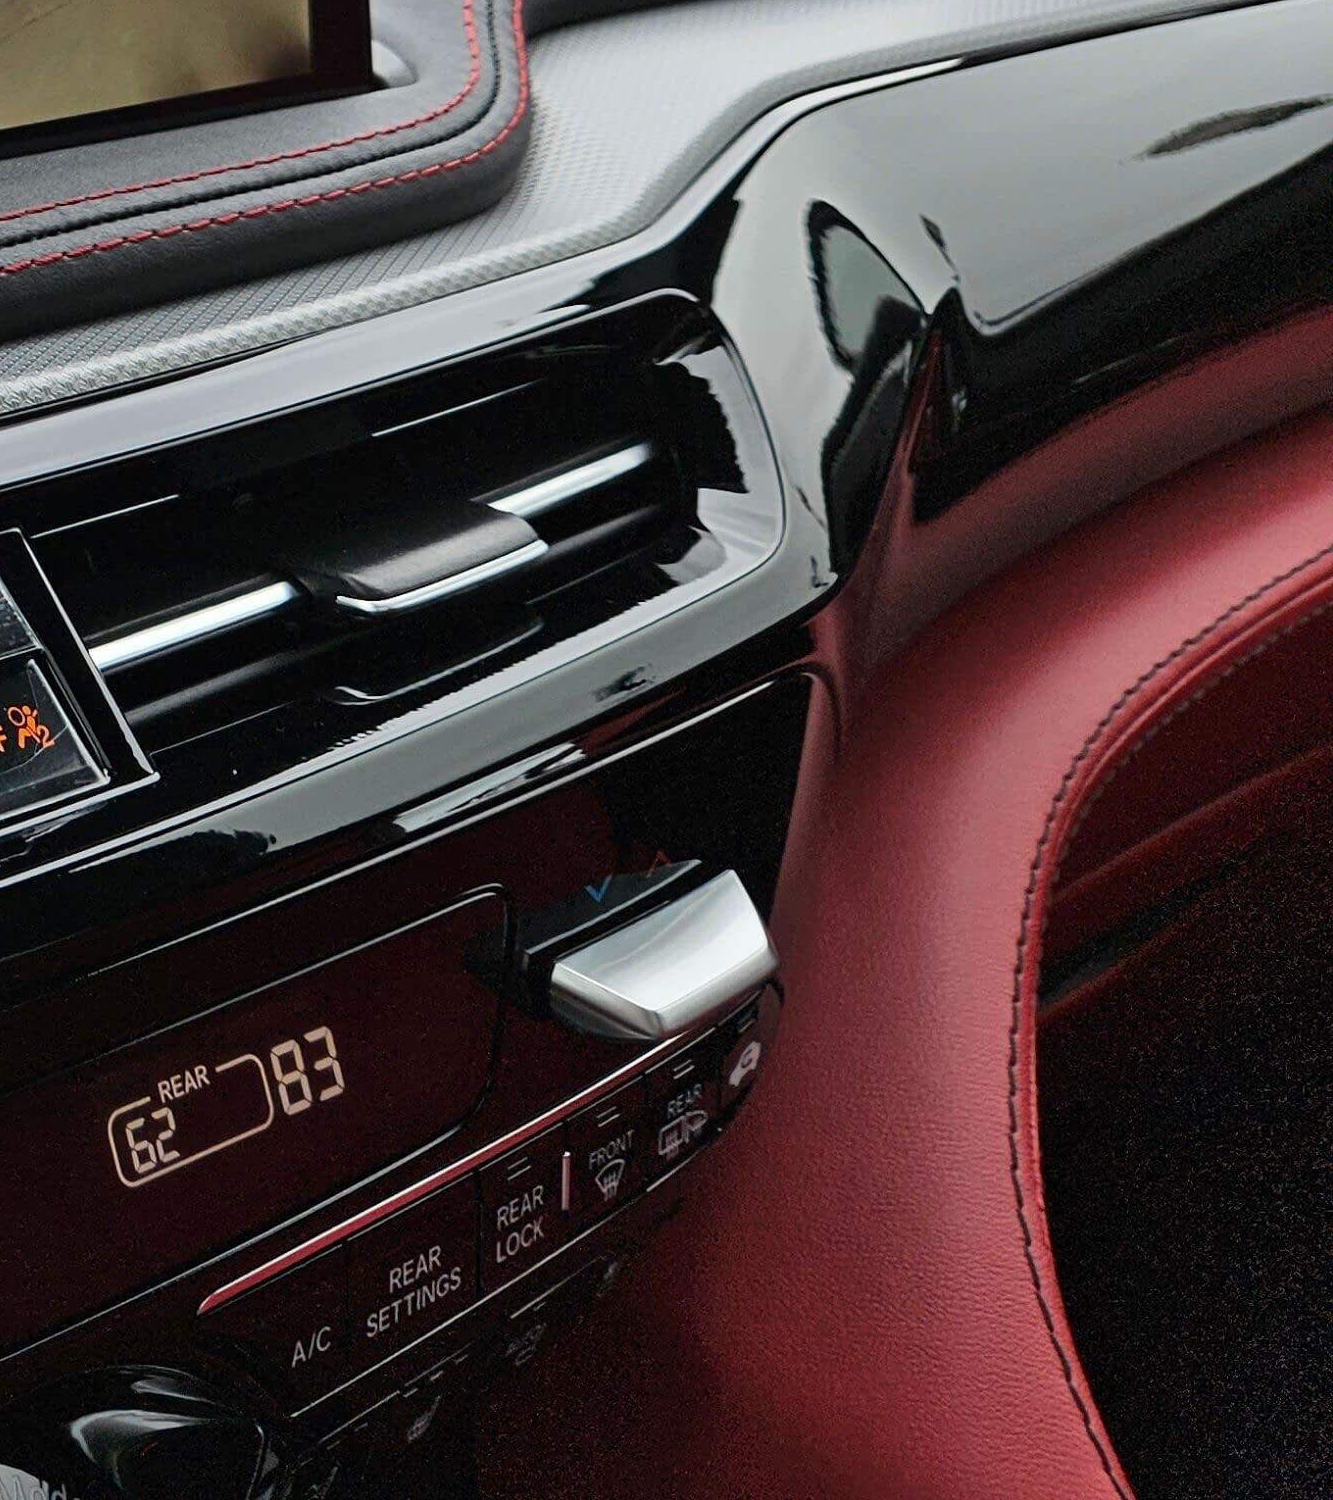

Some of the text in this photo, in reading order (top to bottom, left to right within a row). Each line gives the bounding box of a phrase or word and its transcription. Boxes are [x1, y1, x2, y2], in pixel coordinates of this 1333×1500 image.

[157, 1064, 211, 1103] REAR
[269, 1025, 346, 1116] 83
[667, 1083, 702, 1119] REAR
[125, 1106, 181, 1174] 62
[588, 1129, 635, 1170] FRONT
[495, 1184, 545, 1231] REAR
[495, 1215, 545, 1264] LOCK
[388, 1244, 442, 1293] REAR
[366, 1266, 463, 1338] SETTINGS
[290, 1325, 333, 1369] A/C
